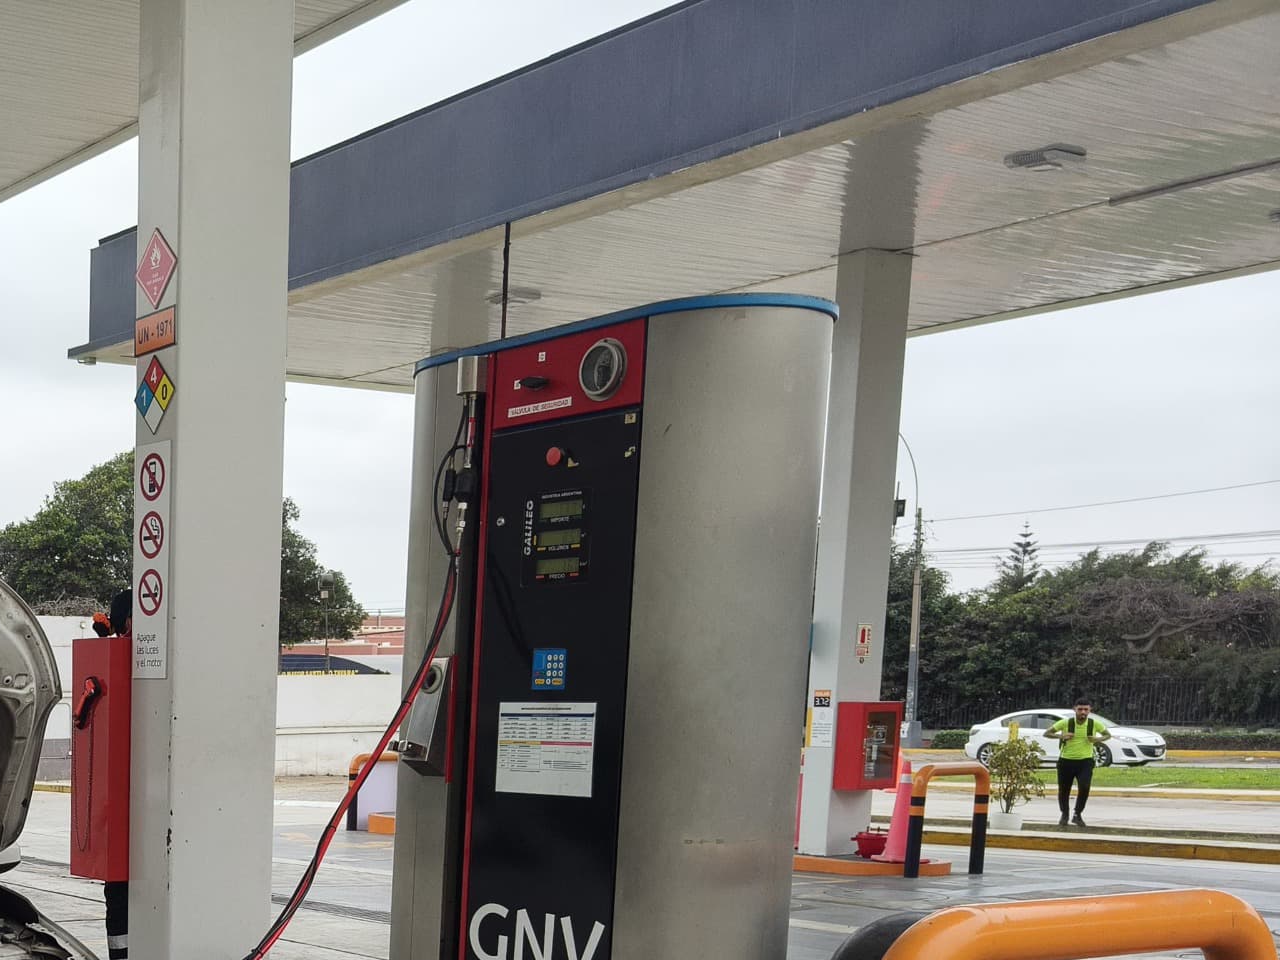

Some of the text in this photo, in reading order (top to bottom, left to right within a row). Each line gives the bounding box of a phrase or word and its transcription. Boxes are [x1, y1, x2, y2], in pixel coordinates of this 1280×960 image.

[138, 326, 149, 344] UN
[157, 319, 172, 339] 1971
[151, 367, 157, 384] 4
[141, 389, 146, 406] 1
[162, 384, 168, 400] 0
[532, 404, 540, 412] DE
[524, 500, 534, 555] GALILEO
[137, 633, 156, 643] Apague
